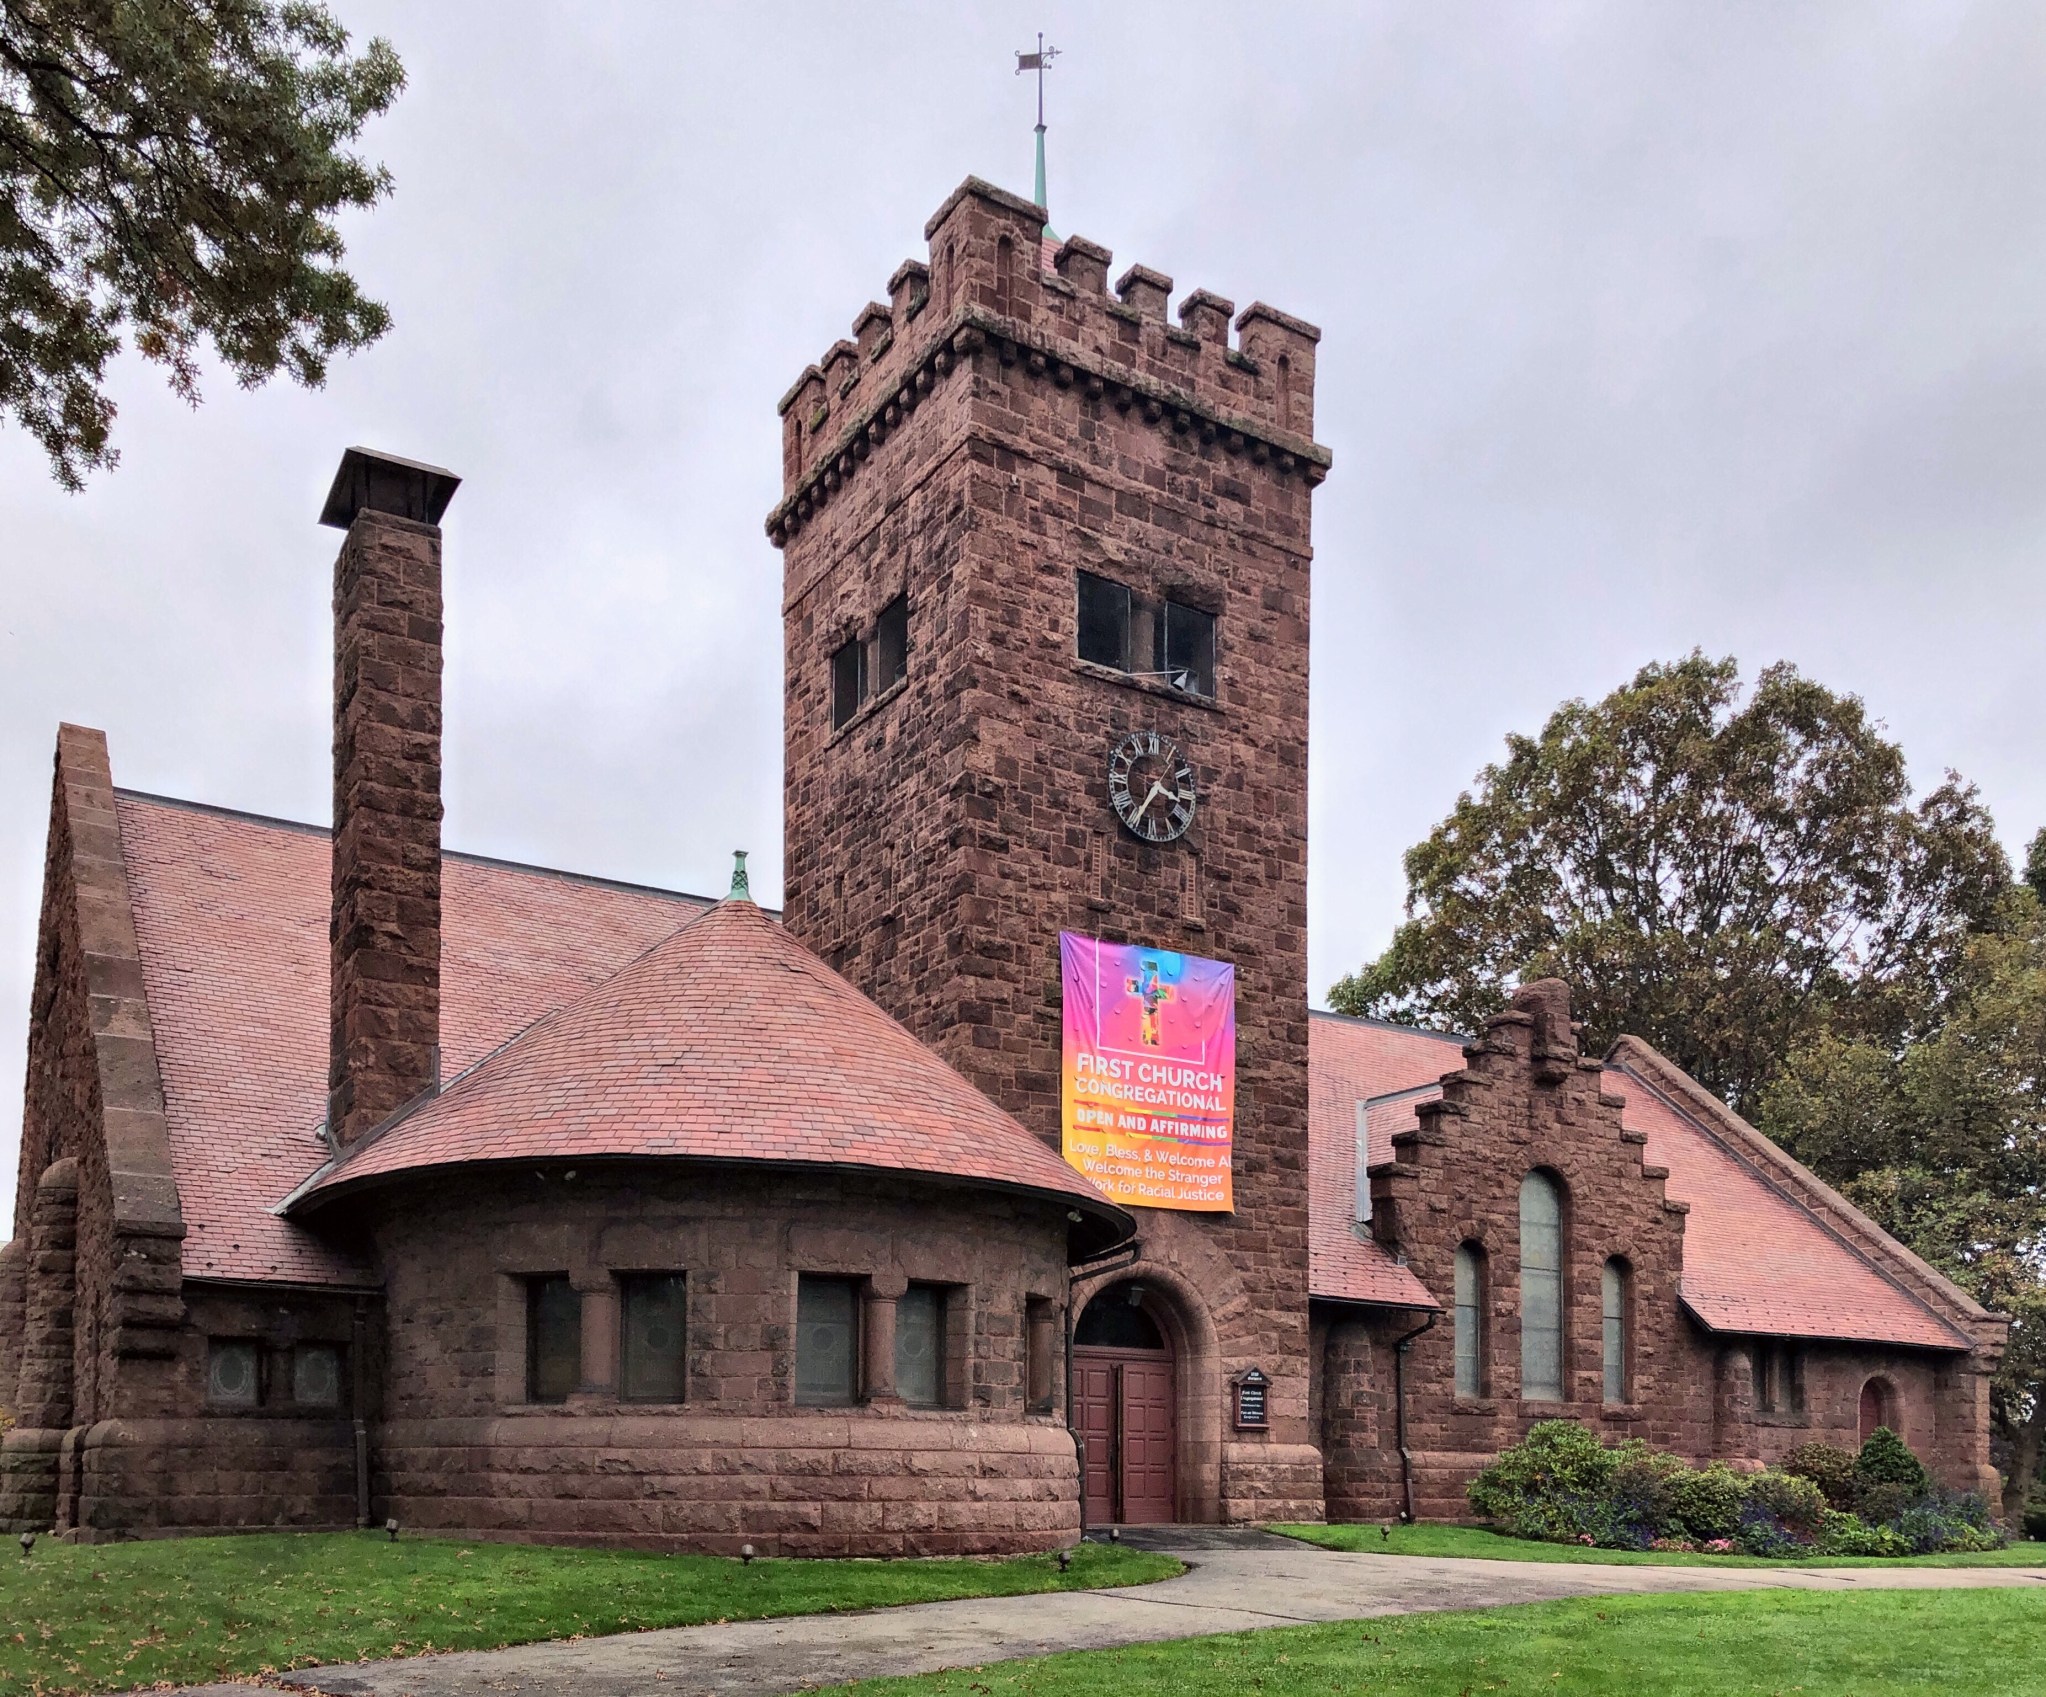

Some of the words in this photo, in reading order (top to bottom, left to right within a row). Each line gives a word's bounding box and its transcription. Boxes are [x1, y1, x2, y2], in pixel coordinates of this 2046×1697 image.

[1117, 749, 1133, 766] X
[1148, 736, 1160, 755] XII
[1077, 1052, 1135, 1080] FIRST
[1138, 1063, 1223, 1092] CHURCH
[1075, 1077, 1227, 1111] CONGREGATIONAL
[1077, 1108, 1114, 1127] OPEN
[1117, 1114, 1147, 1131] AND
[1150, 1118, 1228, 1139] AFFIRMING
[1069, 1139, 1102, 1156] Love,
[1105, 1143, 1141, 1162] Bless,
[1144, 1148, 1154, 1162] &
[1155, 1150, 1216, 1168] Welcome
[1083, 1158, 1143, 1177] Welcome
[1145, 1166, 1166, 1181] the
[1168, 1169, 1223, 1188] Stranger
[1118, 1180, 1136, 1195] for
[1138, 1182, 1175, 1199] Racial
[1178, 1186, 1225, 1201] Justice
